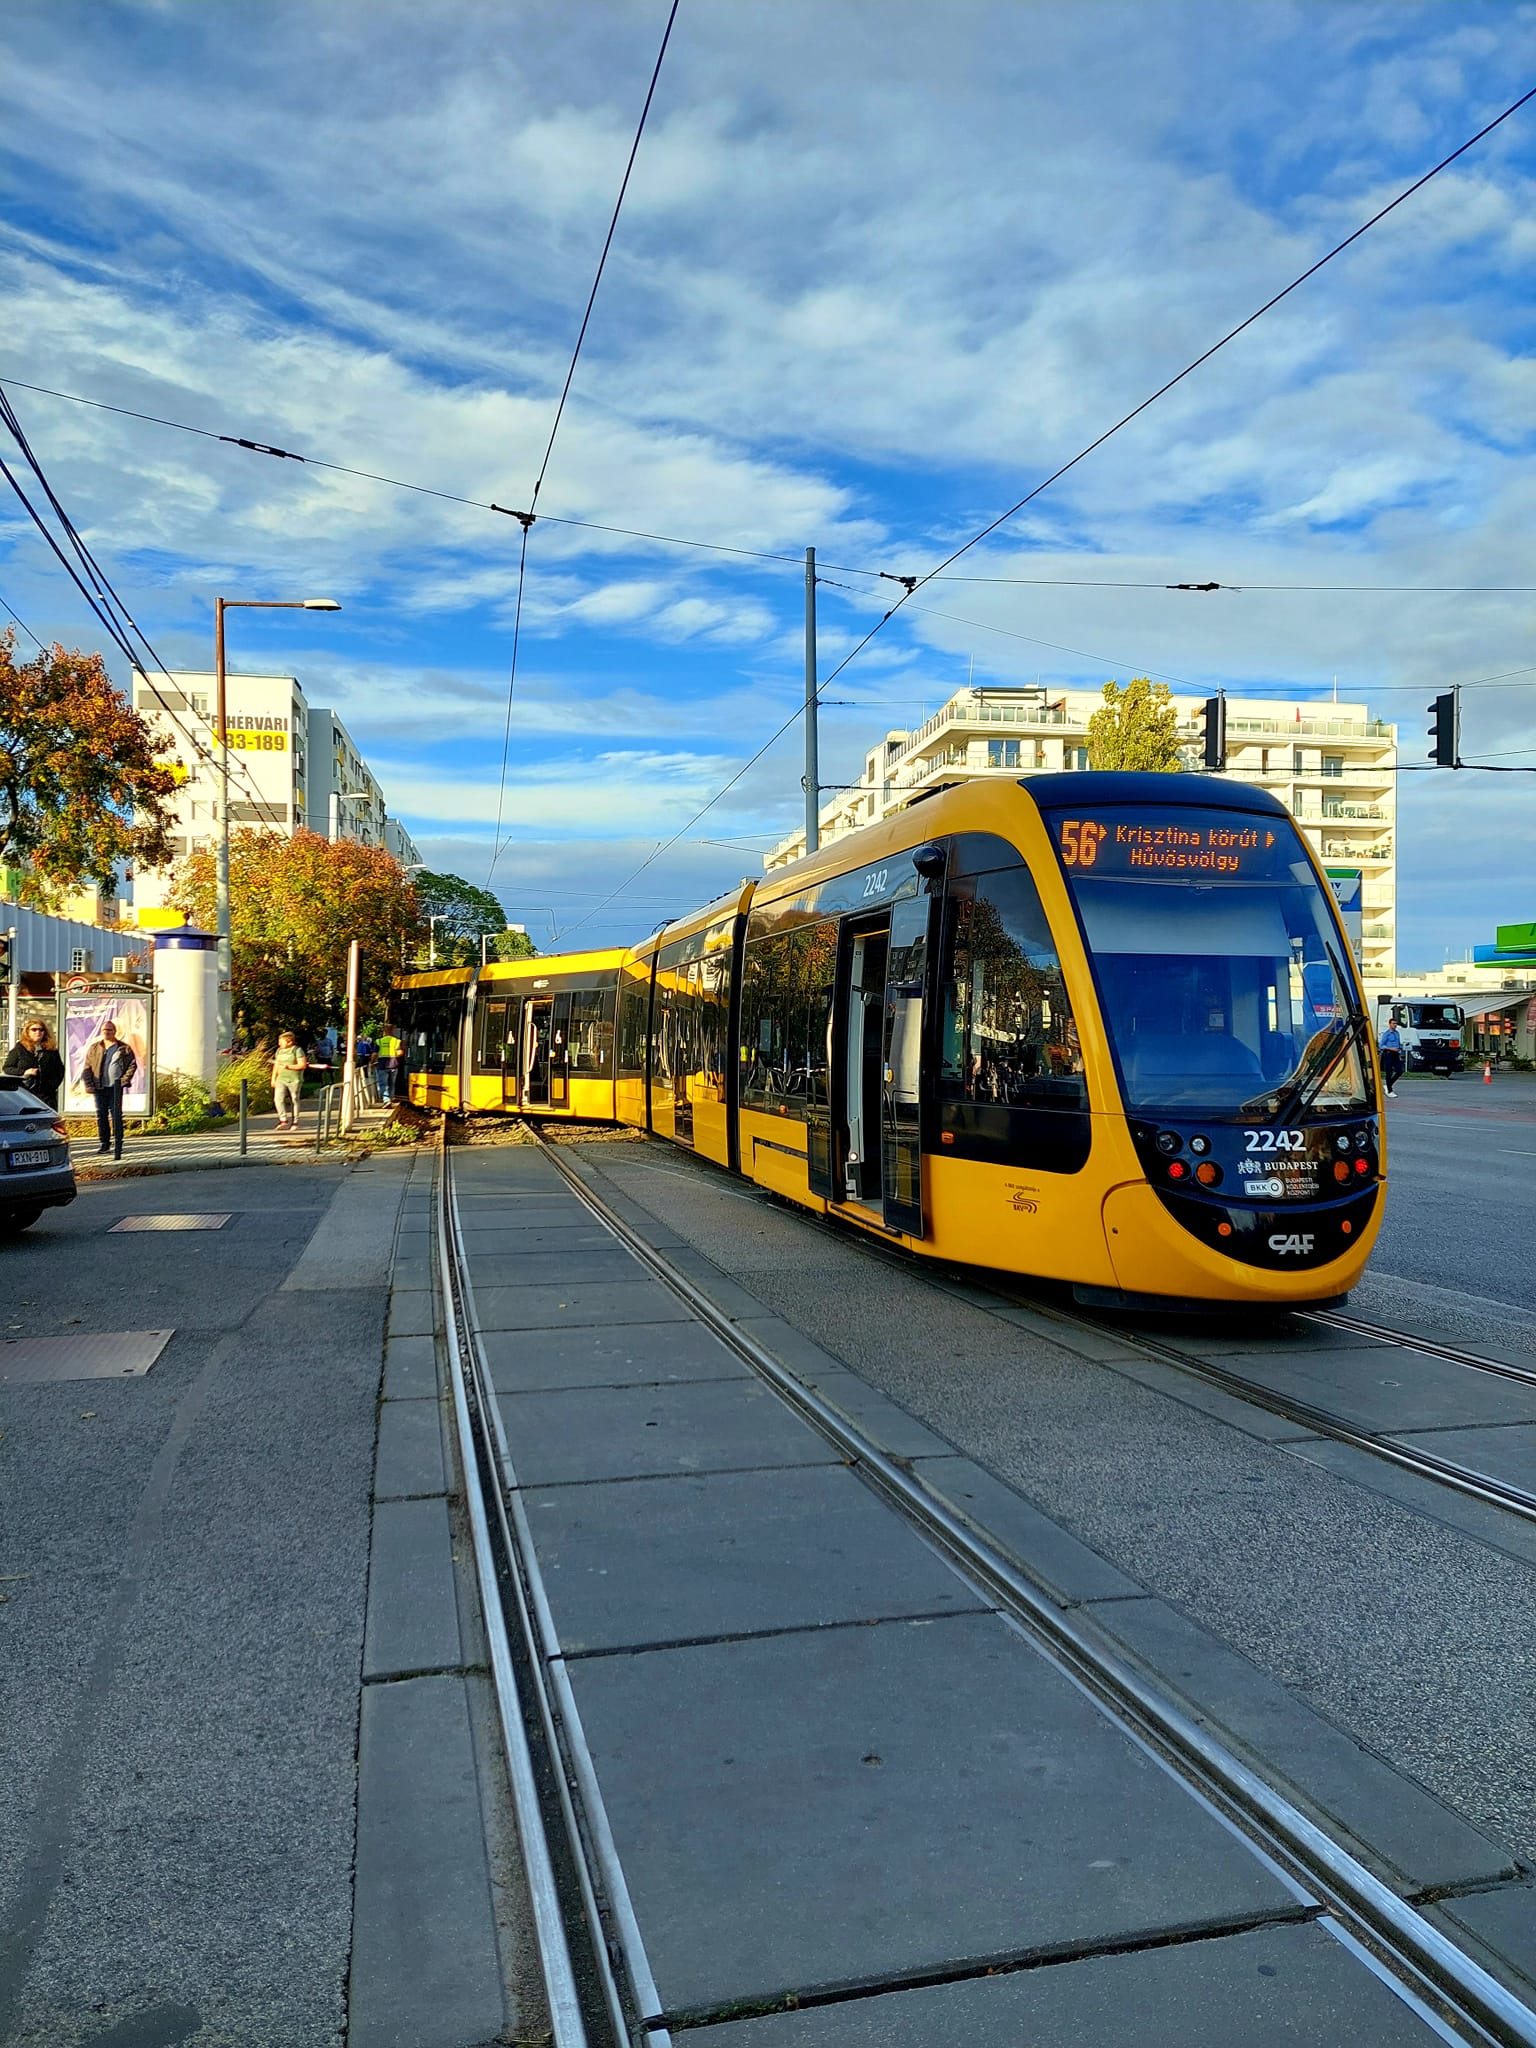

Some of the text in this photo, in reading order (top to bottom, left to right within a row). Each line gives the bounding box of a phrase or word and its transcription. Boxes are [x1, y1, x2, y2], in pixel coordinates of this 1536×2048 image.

[223, 733, 285, 751] 83-189
[1061, 821, 1097, 866] 56
[1116, 825, 1258, 847] Krisztina körút
[1130, 847, 1239, 871] Hűvösvölgy
[863, 869, 888, 897] 2242
[1243, 1130, 1307, 1151] 2242
[1264, 1161, 1318, 1171] BUDAPEST
[1268, 1234, 1315, 1255] CAF
